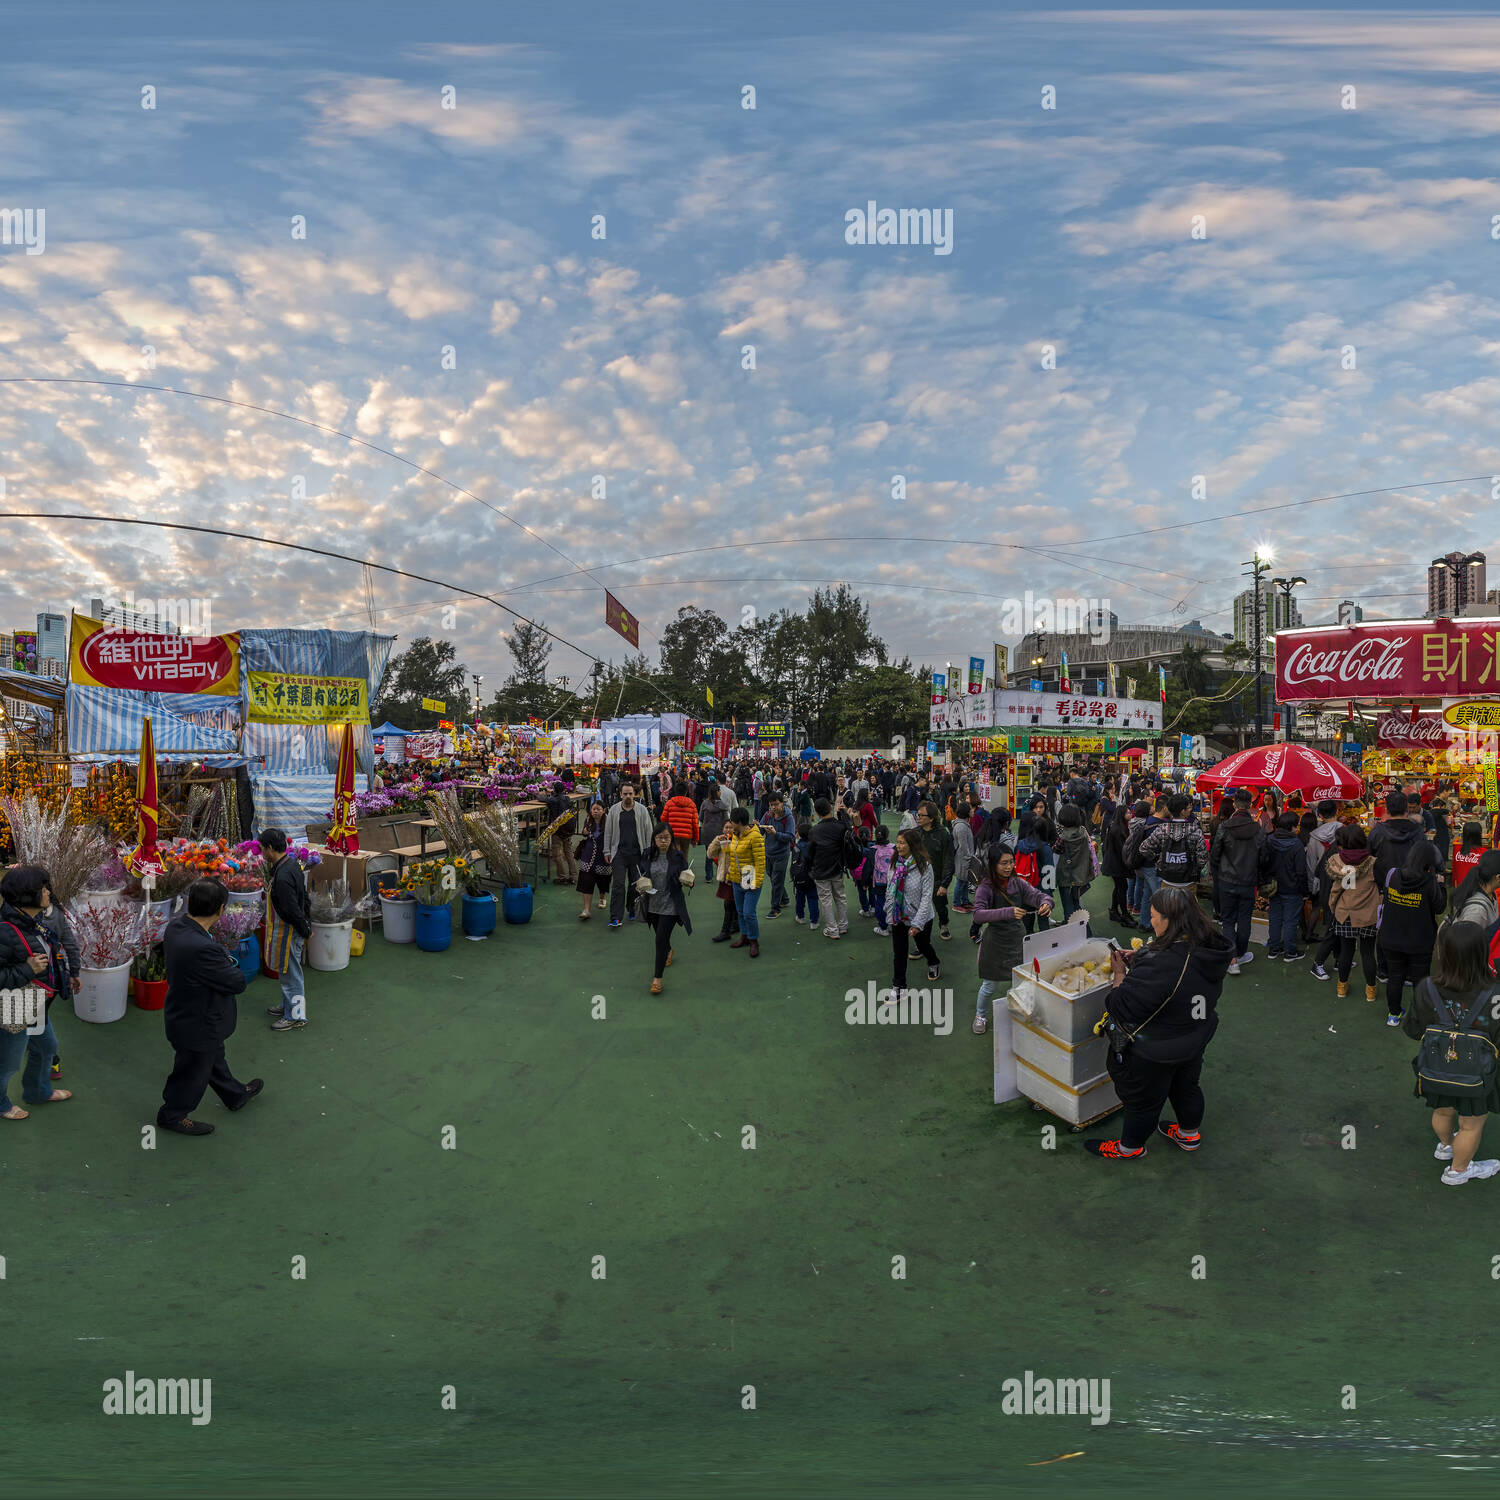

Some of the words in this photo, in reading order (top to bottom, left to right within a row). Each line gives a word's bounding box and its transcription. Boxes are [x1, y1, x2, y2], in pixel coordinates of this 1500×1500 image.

[98, 636, 192, 664] 維他奶
[1284, 636, 1412, 686] Coca-Cola
[1261, 750, 1283, 778] Coca-Cola
